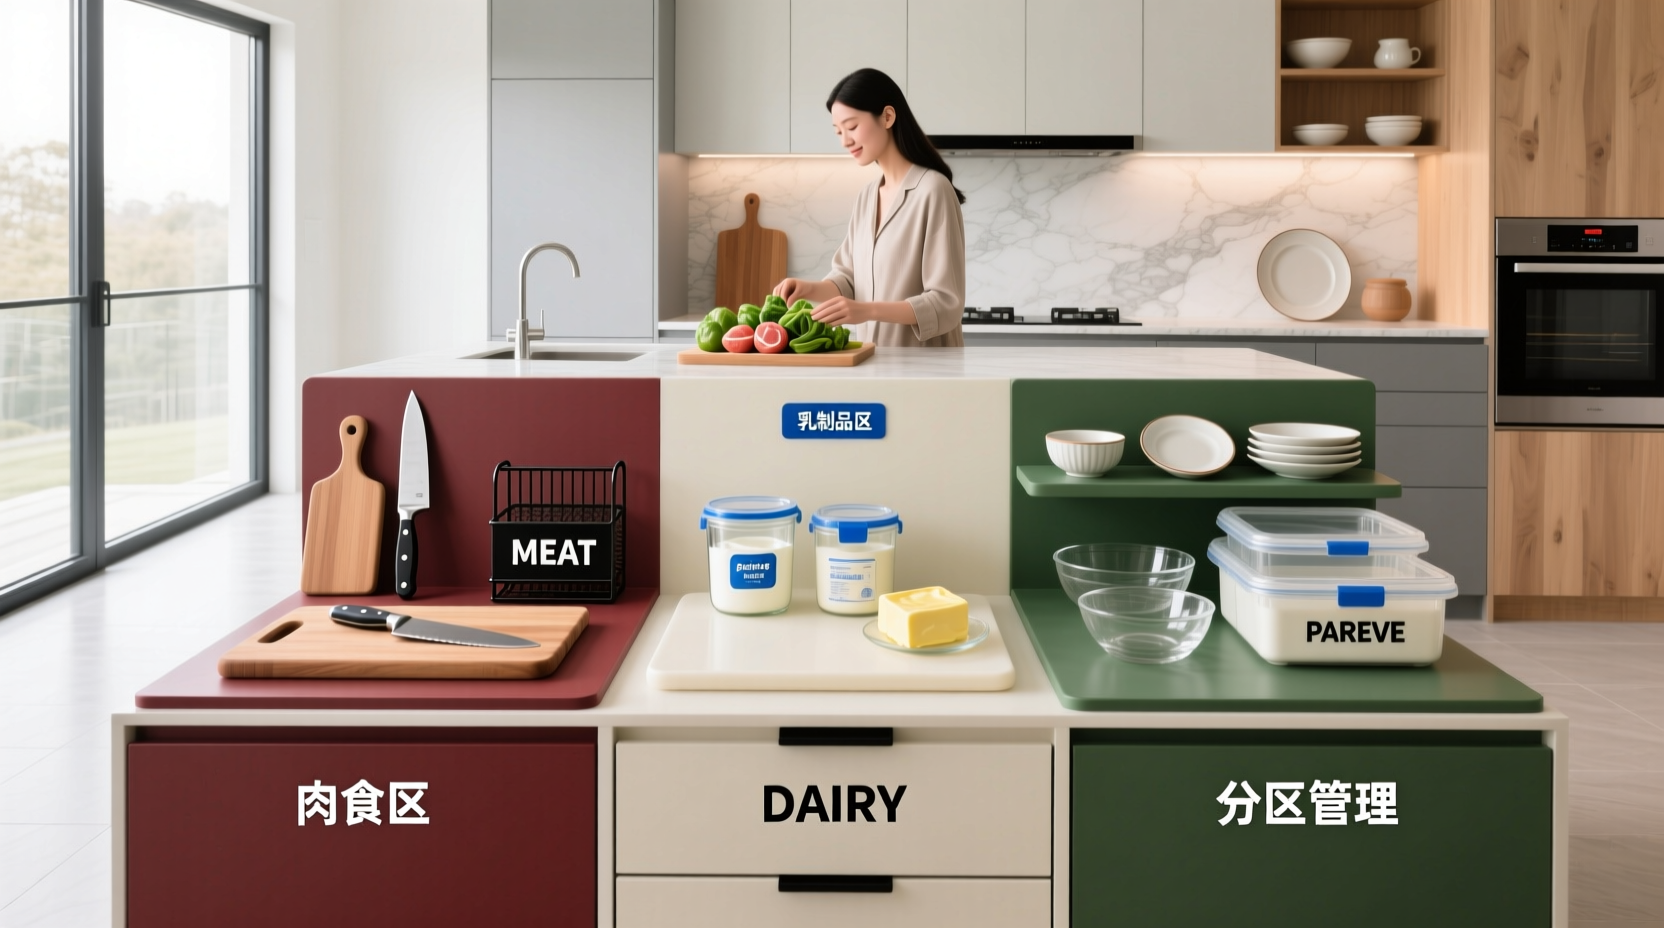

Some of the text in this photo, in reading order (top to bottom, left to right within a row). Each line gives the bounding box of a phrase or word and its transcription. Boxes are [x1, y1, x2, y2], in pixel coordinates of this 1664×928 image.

[797, 410, 873, 432] 乳制品区
[512, 538, 597, 566] MEAT
[1306, 621, 1406, 643] PAREVE
[297, 778, 430, 827] 肉食区
[763, 784, 908, 823] DAIRY
[1215, 779, 1399, 827] 分区管理
